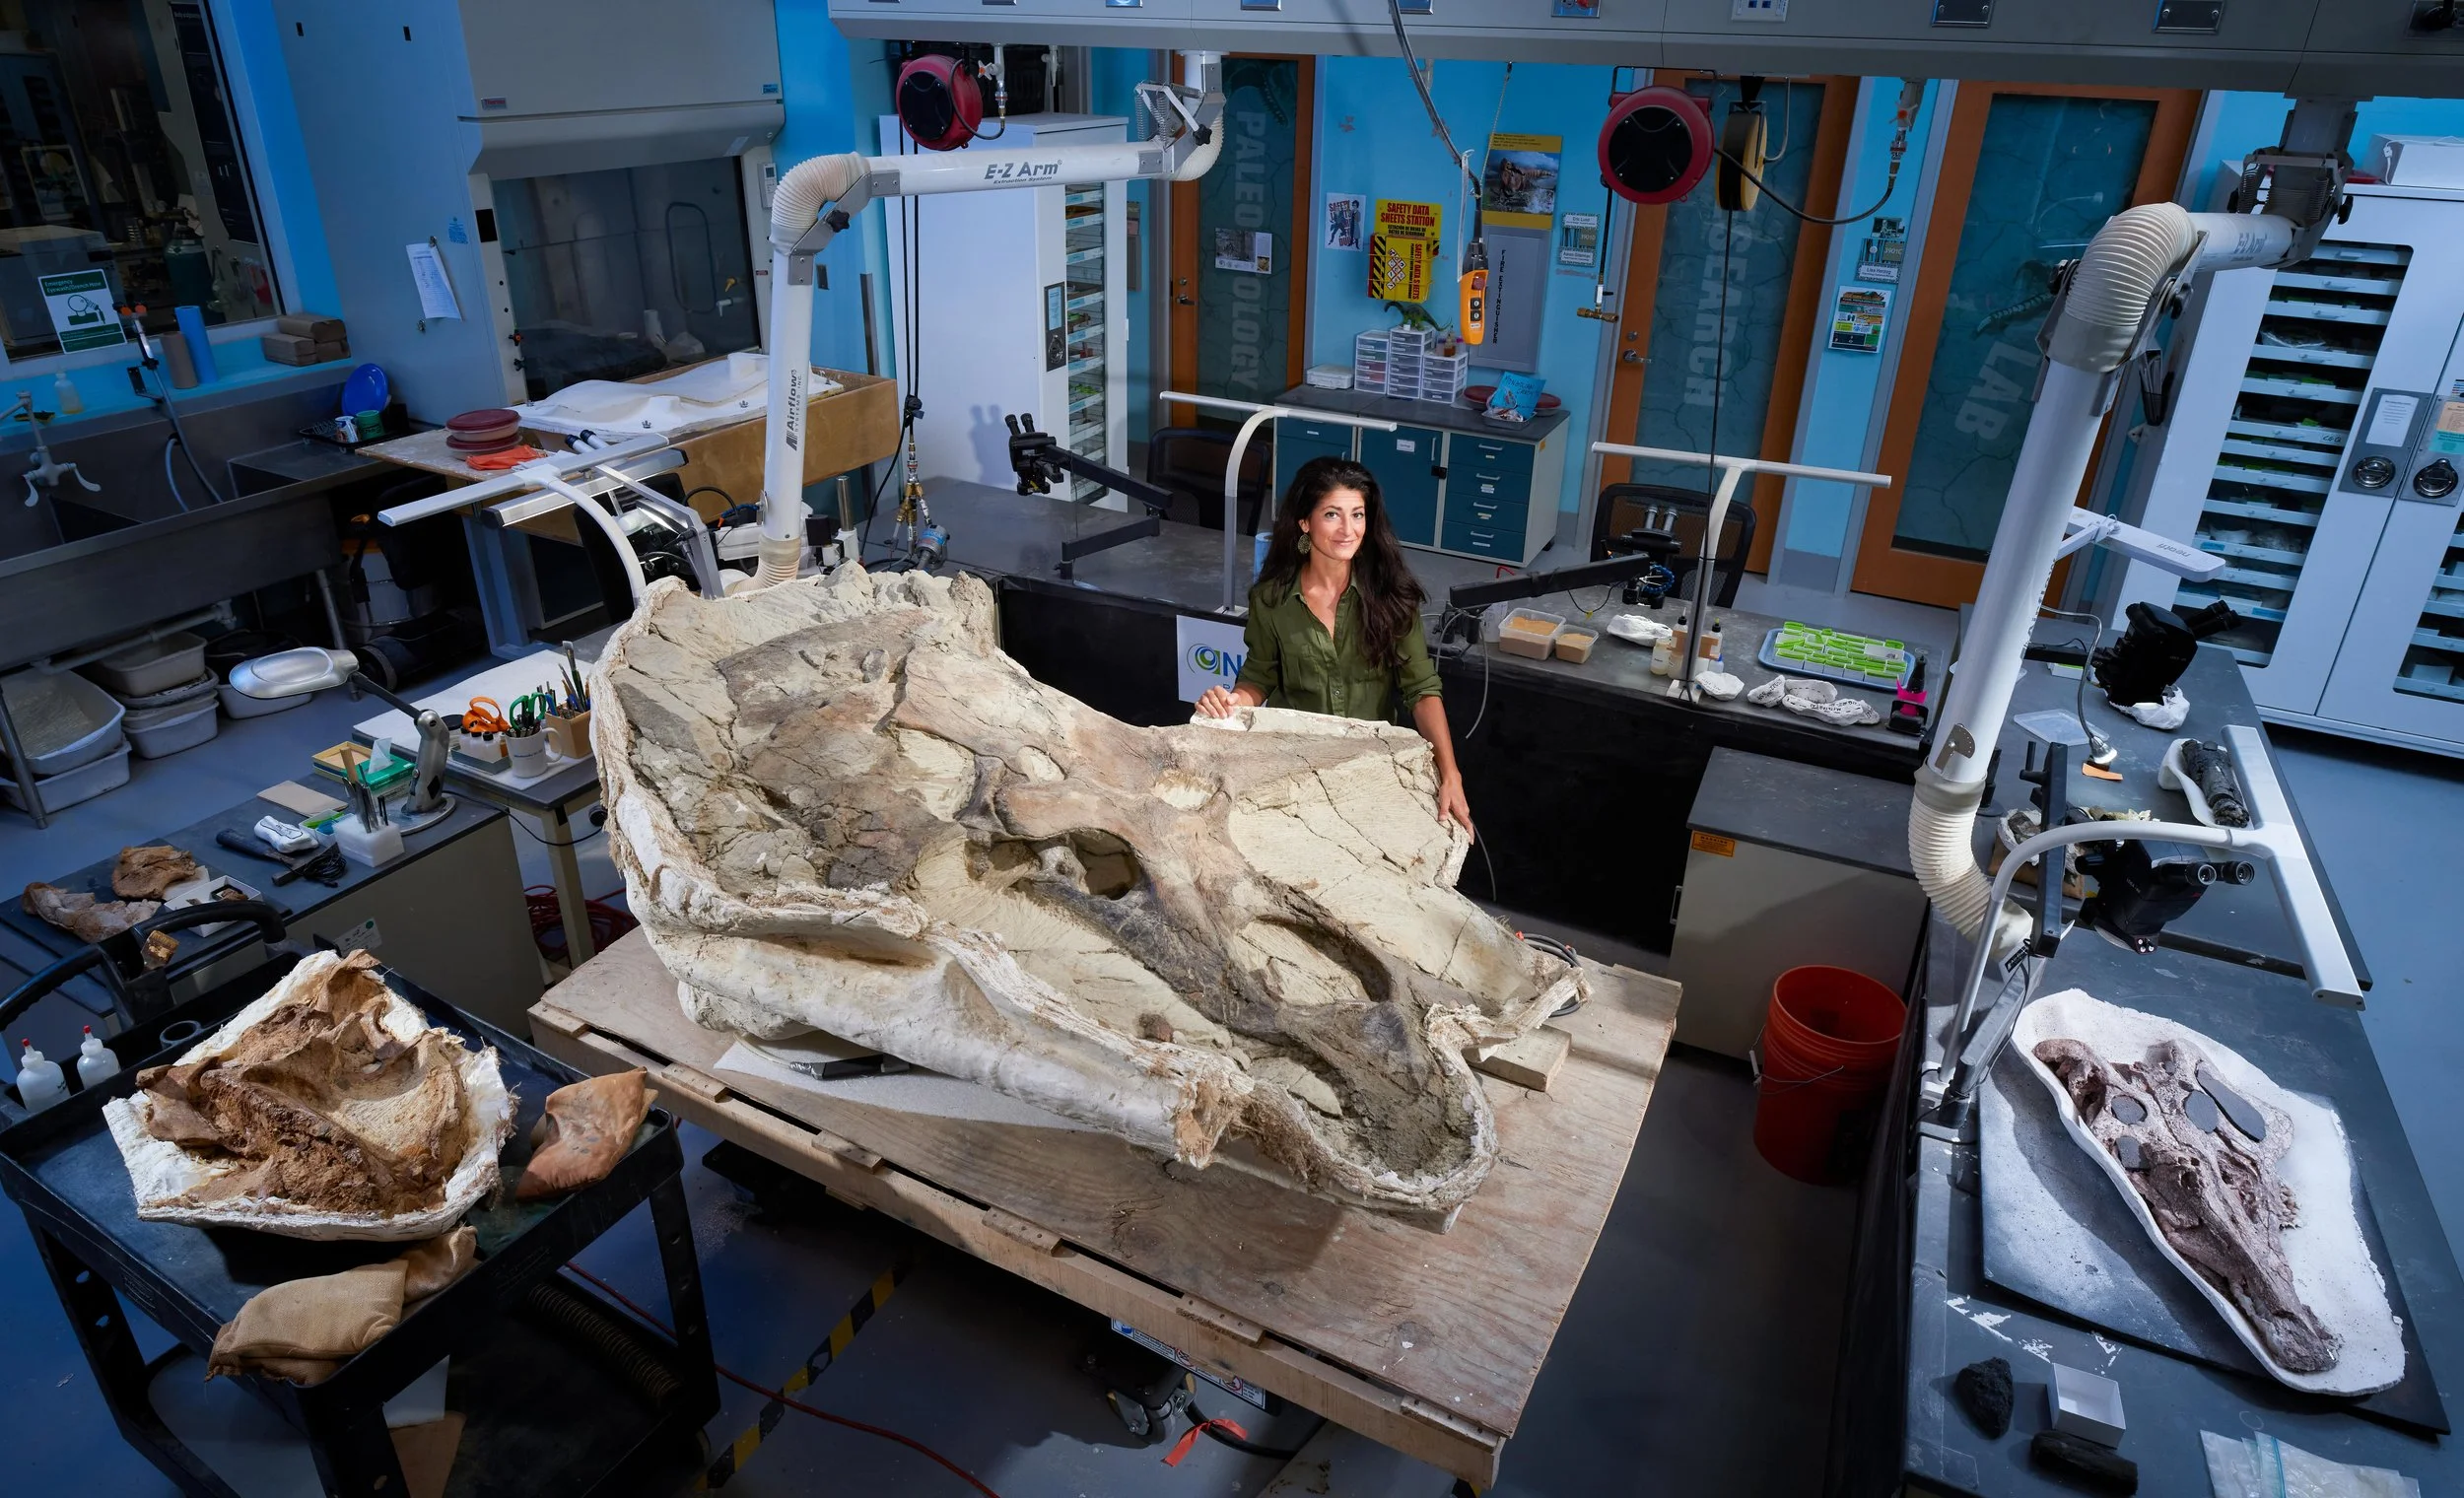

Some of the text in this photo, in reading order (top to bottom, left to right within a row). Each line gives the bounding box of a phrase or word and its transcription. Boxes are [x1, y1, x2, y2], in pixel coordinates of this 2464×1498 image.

[985, 162, 1059, 179] E-Z Arm
[1381, 213, 1435, 227] SHEETS STATION
[1387, 202, 1430, 215] SAFETY DATA
[1229, 111, 1266, 390] PALEOOLOGY
[1414, 243, 1423, 265] SAFETY
[1492, 275, 1504, 344] EXTINGUISHER
[1683, 202, 1758, 408] SEARCH
[787, 374, 797, 431] Airflow
[1954, 340, 2043, 441] LAB
